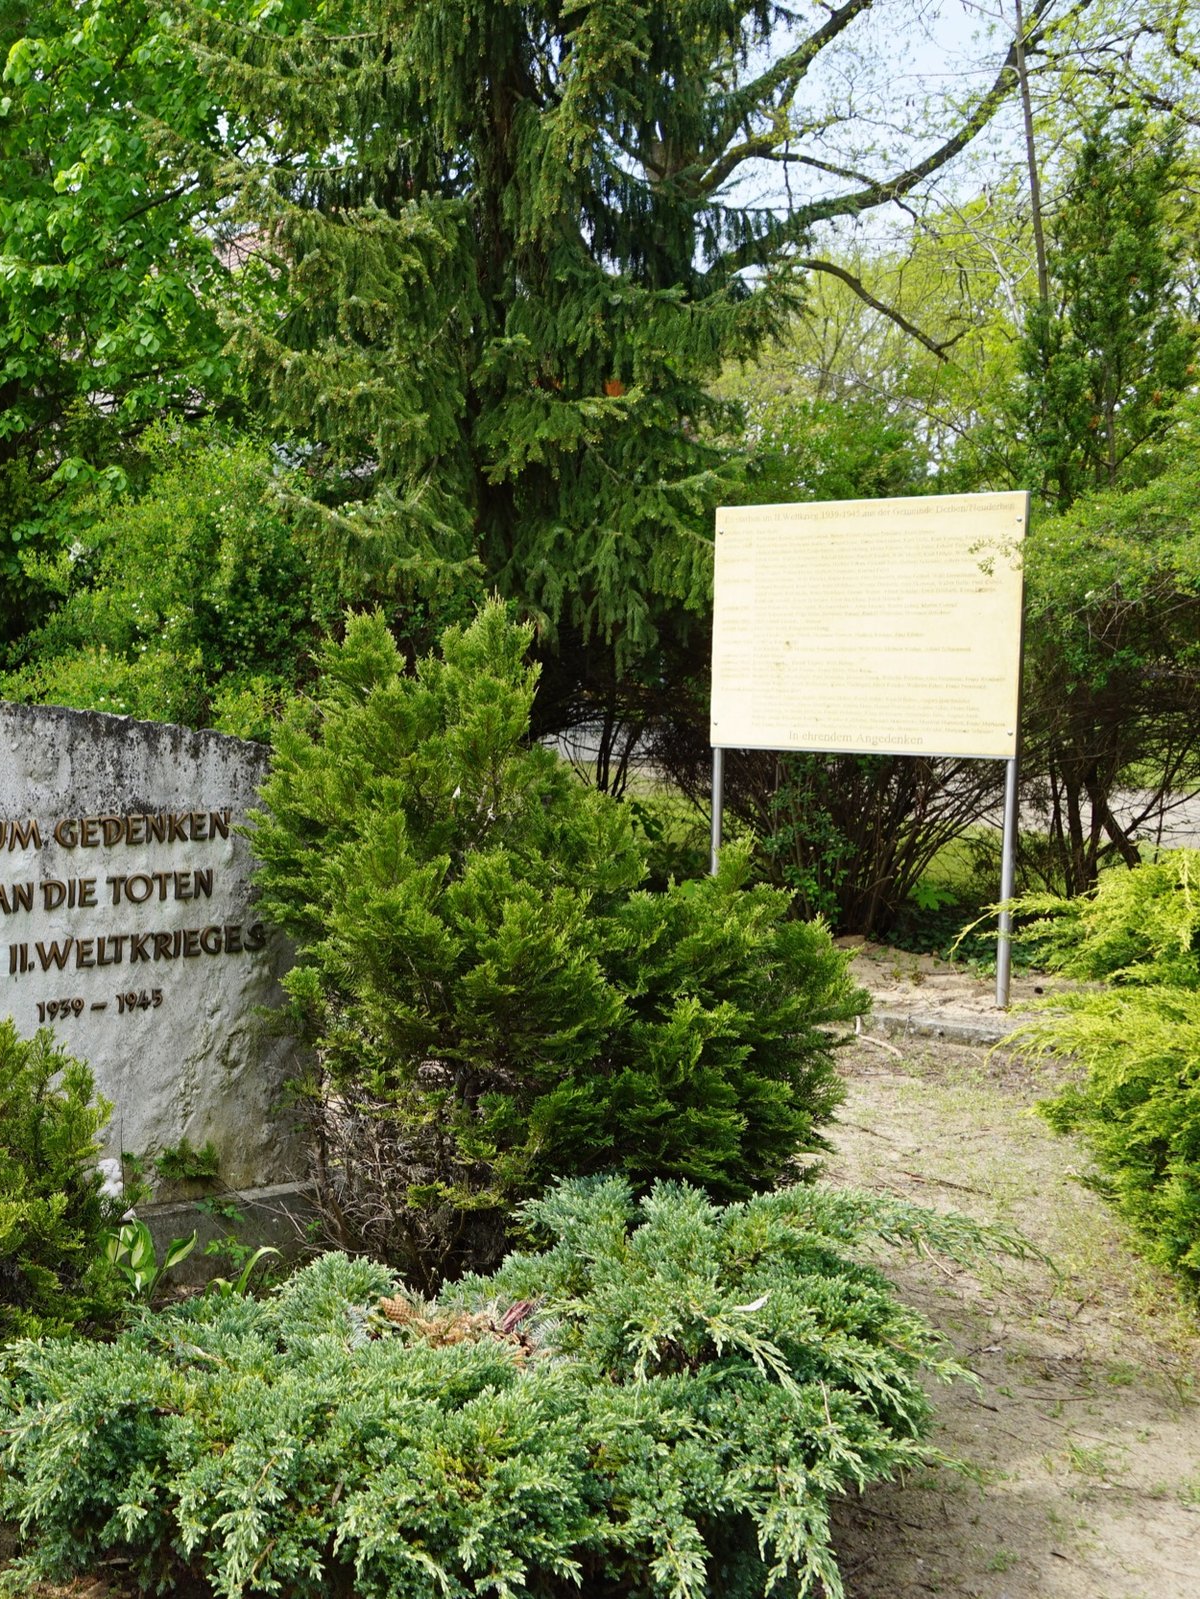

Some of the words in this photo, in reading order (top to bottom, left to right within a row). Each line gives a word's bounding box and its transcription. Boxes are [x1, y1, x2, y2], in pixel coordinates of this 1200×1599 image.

[801, 731, 852, 742] ehrendem
[855, 733, 924, 746] Angedenken
[53, 811, 230, 849] GEDENKEN
[40, 877, 98, 912] DIE
[106, 869, 214, 905] TOTEN
[36, 998, 85, 1023] 1939
[116, 988, 164, 1014] 1945
